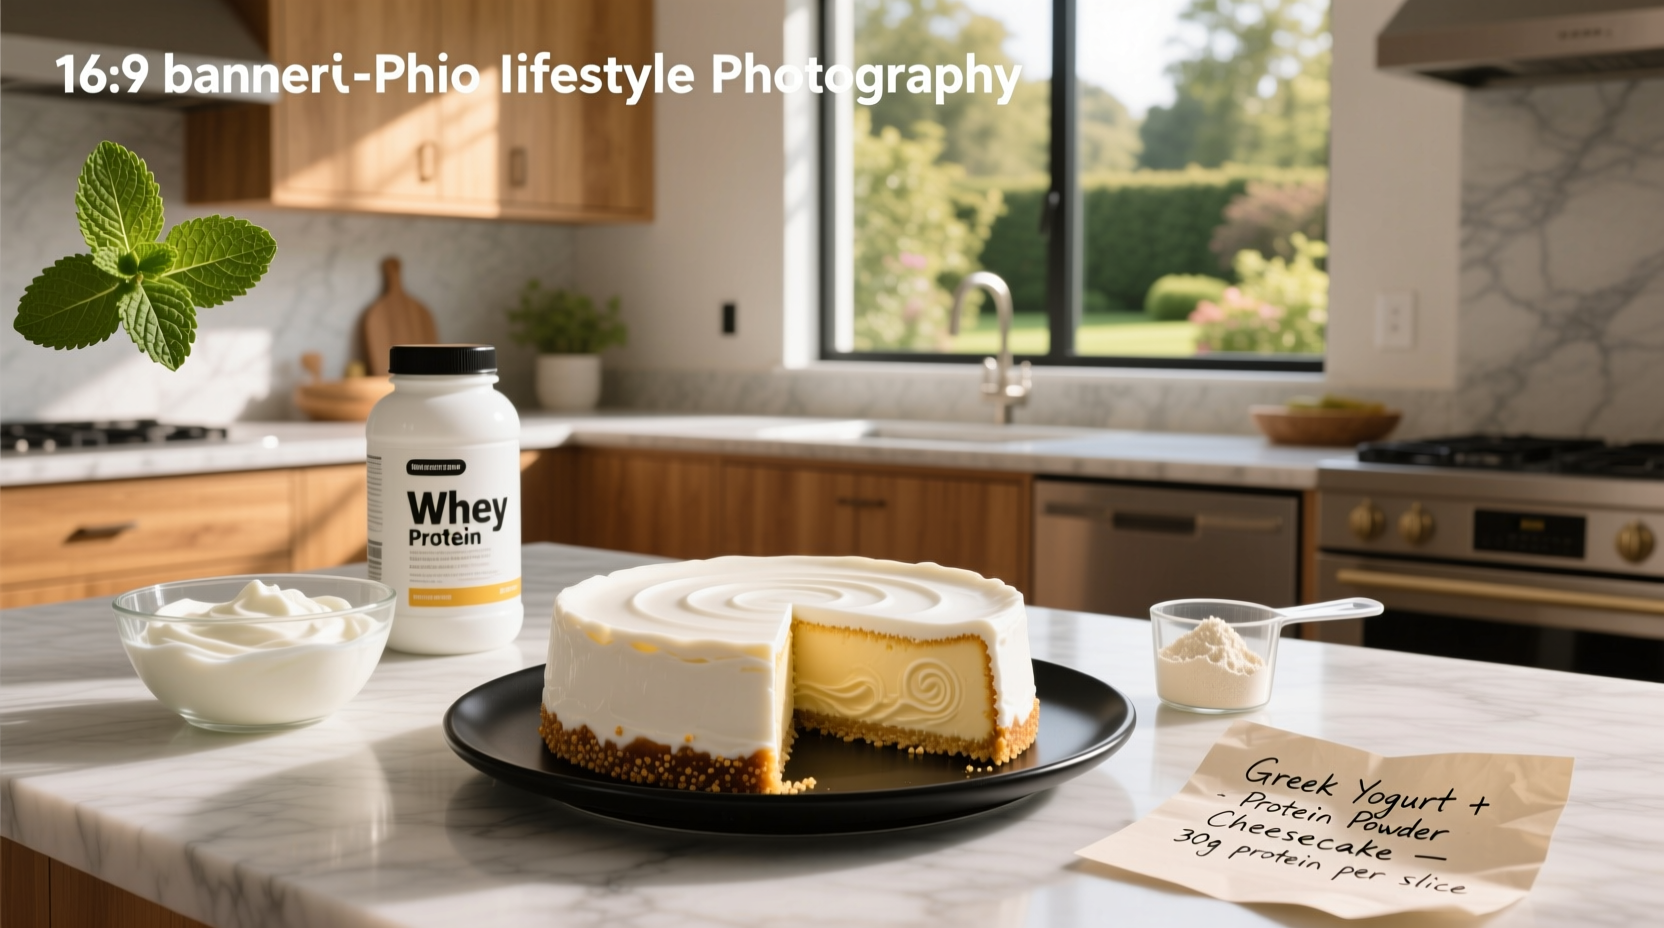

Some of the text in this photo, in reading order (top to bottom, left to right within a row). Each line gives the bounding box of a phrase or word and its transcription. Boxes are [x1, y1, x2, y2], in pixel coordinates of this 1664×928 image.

[407, 489, 508, 532] Whey
[409, 527, 481, 547] Protein
[1245, 756, 1491, 819] Greek Yogurt +
[1206, 809, 1393, 861] Cheesecake
[1238, 790, 1332, 825] Protein
[1346, 809, 1451, 842] Powder
[1172, 827, 1468, 895] 30g protein per slice
